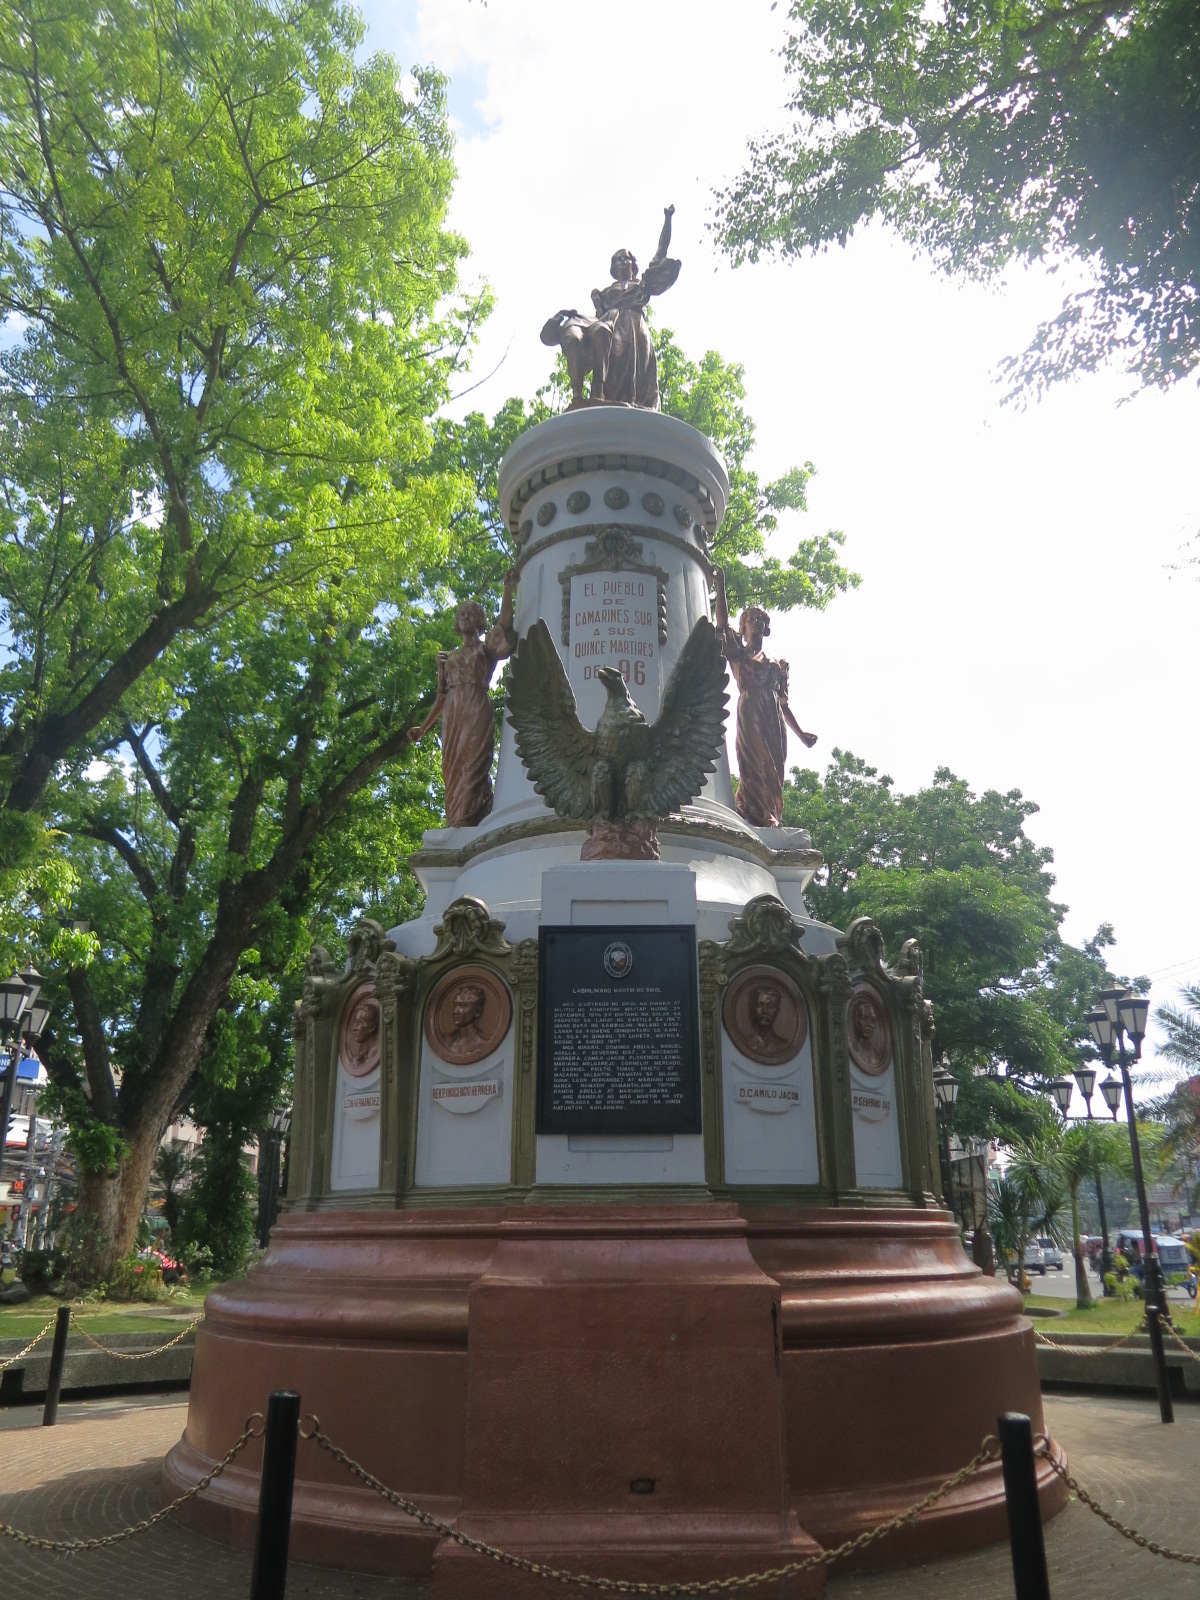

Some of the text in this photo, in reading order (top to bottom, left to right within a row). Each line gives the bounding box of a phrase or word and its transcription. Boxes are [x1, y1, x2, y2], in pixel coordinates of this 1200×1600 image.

[584, 582, 644, 596] EL PUEBLO
[576, 610, 652, 626] CAMARINES SUR
[575, 640, 653, 658] QUINCE MARTIRES
[584, 659, 646, 686] DE 96
[472, 1084, 496, 1096] HERRERA
[779, 1091, 799, 1100] JACOB
